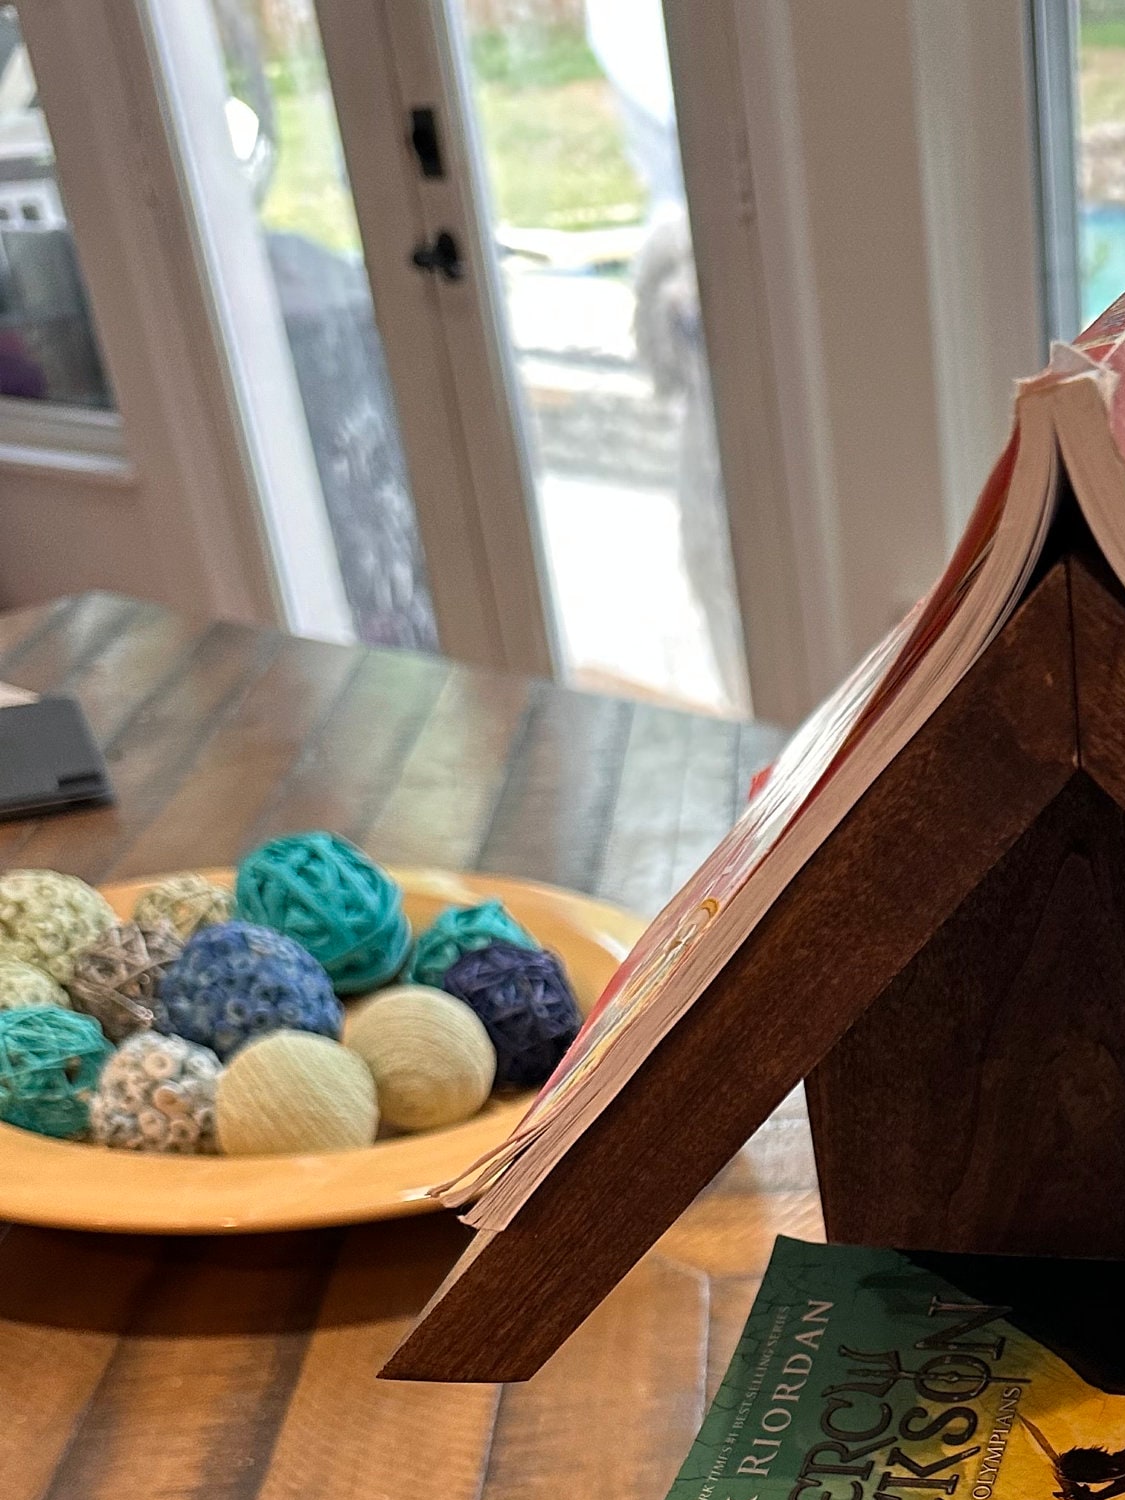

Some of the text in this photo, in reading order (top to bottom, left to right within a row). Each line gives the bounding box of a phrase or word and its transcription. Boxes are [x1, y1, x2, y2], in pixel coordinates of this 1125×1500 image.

[709, 1444, 733, 1484] TIMES
[767, 1306, 791, 1349] SERIES
[737, 1300, 834, 1477] RIORDAN
[972, 1385, 1024, 1500] OLYMPIANS
